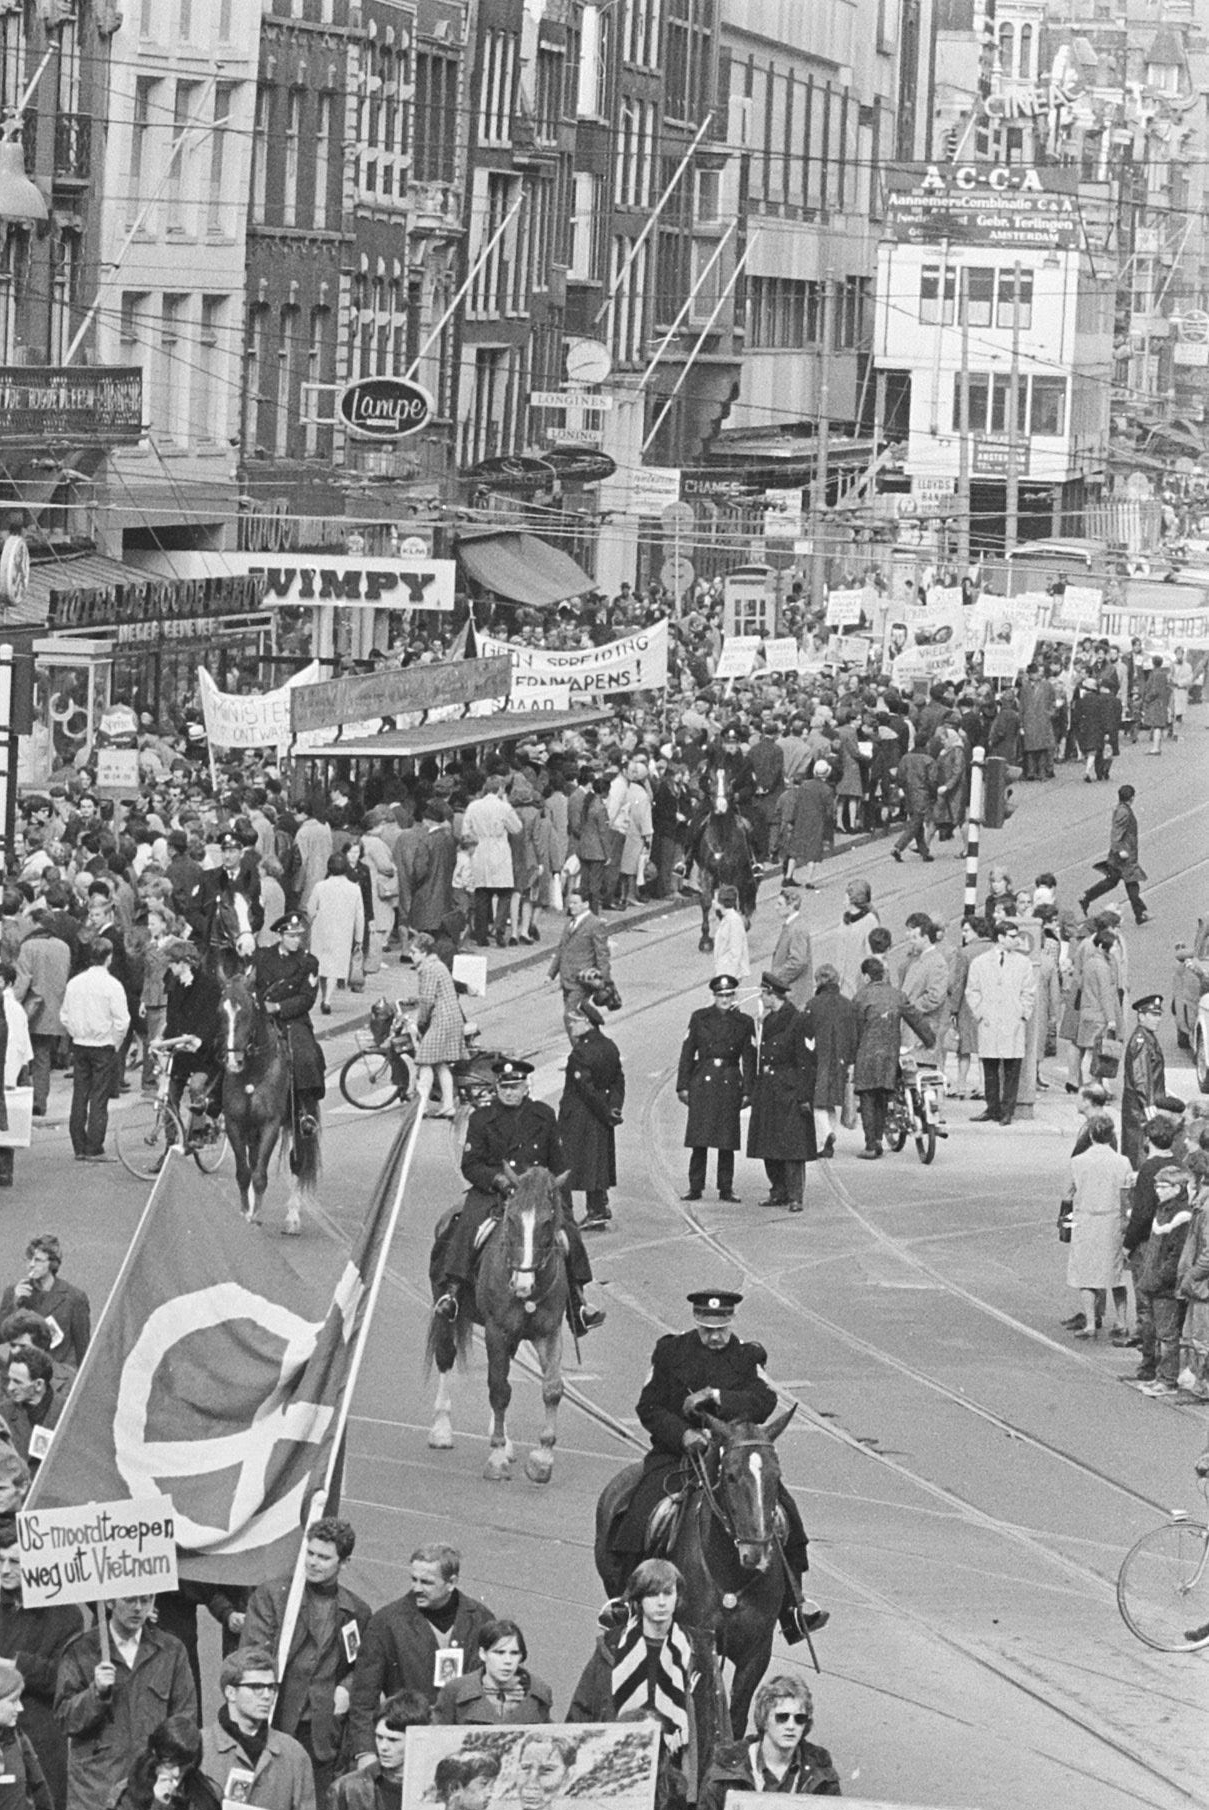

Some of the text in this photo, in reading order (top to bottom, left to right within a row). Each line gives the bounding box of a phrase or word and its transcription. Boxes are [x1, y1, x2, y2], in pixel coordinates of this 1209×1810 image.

[984, 80, 1086, 118] CINEAC
[977, 215, 1010, 228] Gebr.
[990, 230, 1059, 242] AMSTERDAM
[352, 387, 427, 430] Lampe
[537, 393, 607, 408] LONGINES
[249, 566, 436, 602] WIMPY
[17, 1510, 175, 1554] US-moordtroepen
[21, 1545, 171, 1600] weg uit Vietnam
